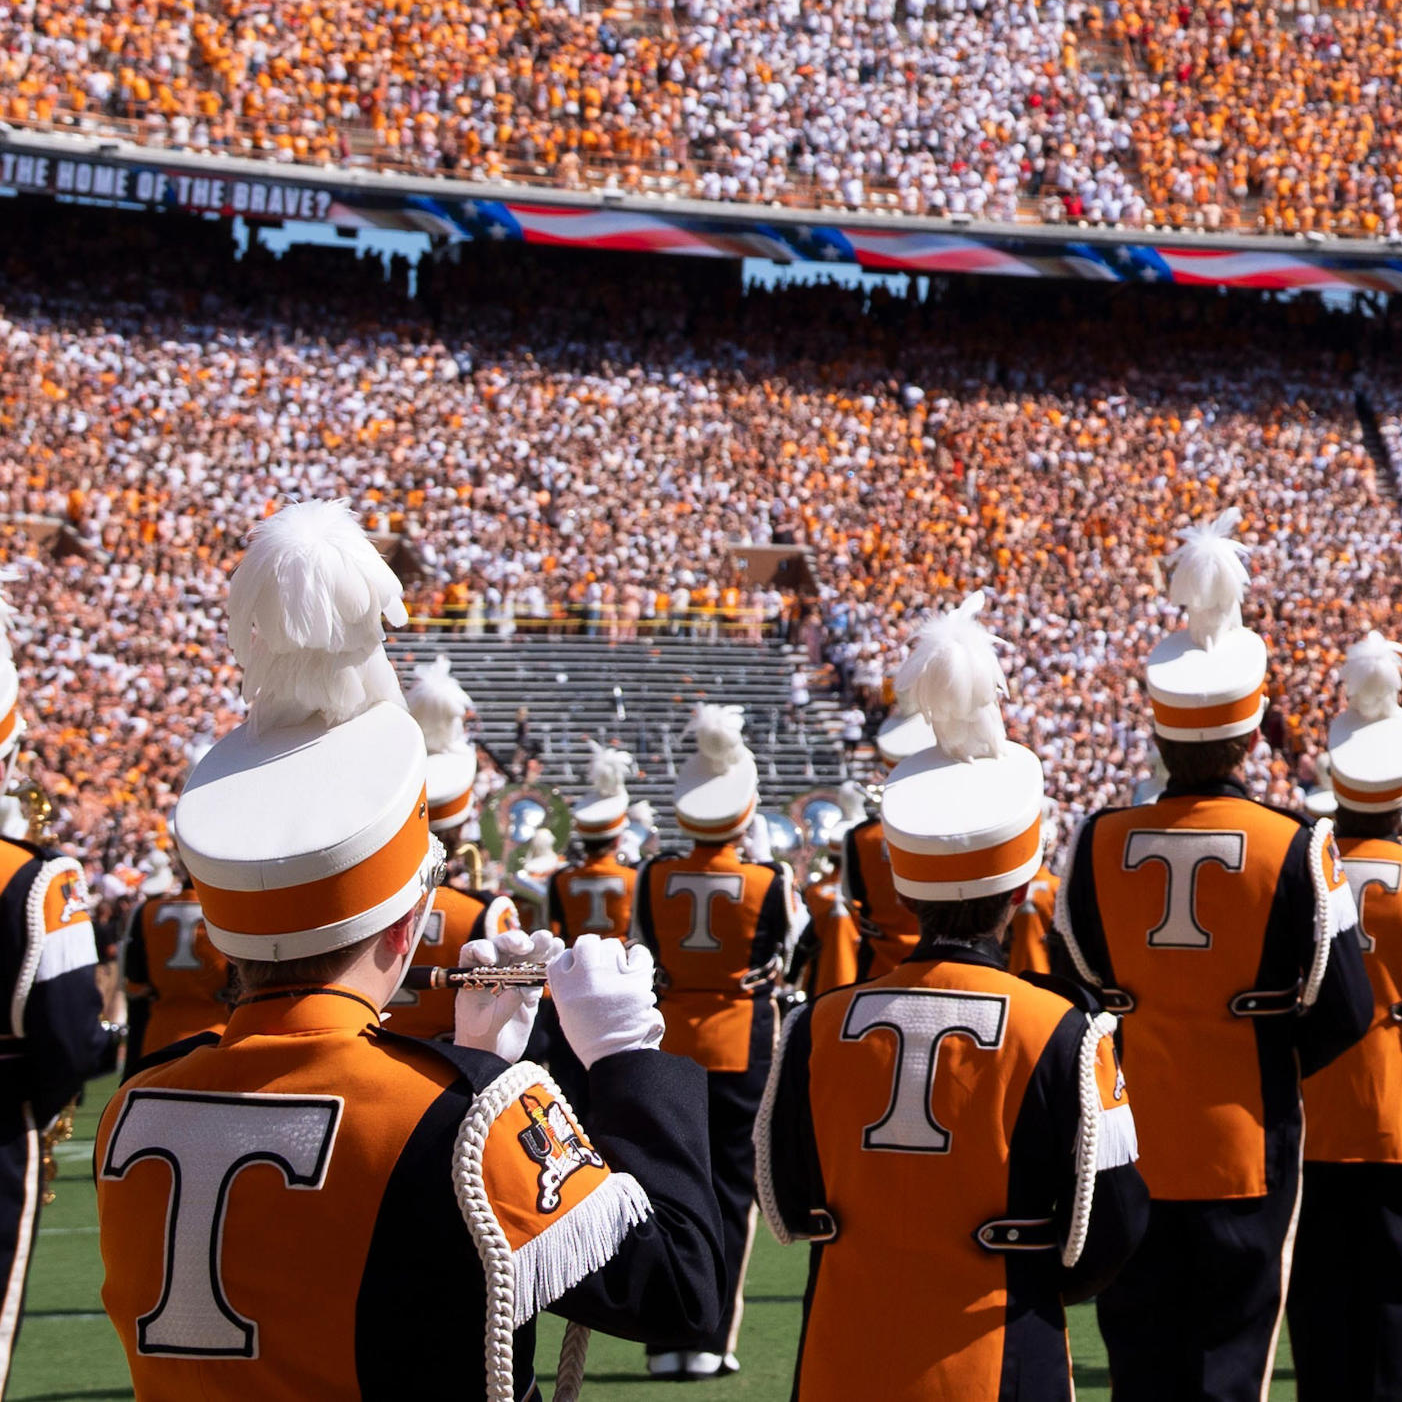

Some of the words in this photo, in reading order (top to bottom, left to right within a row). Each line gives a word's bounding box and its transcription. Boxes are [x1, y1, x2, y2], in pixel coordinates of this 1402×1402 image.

[2, 153, 48, 187] THE
[56, 160, 128, 198] HOME
[136, 171, 168, 203] OF
[177, 175, 225, 209] THE
[233, 181, 332, 219] BRAVE?
[568, 875, 627, 930] T
[667, 870, 746, 951] T
[1122, 829, 1246, 949] T
[838, 989, 1010, 1154] T
[101, 1089, 344, 1360] T
